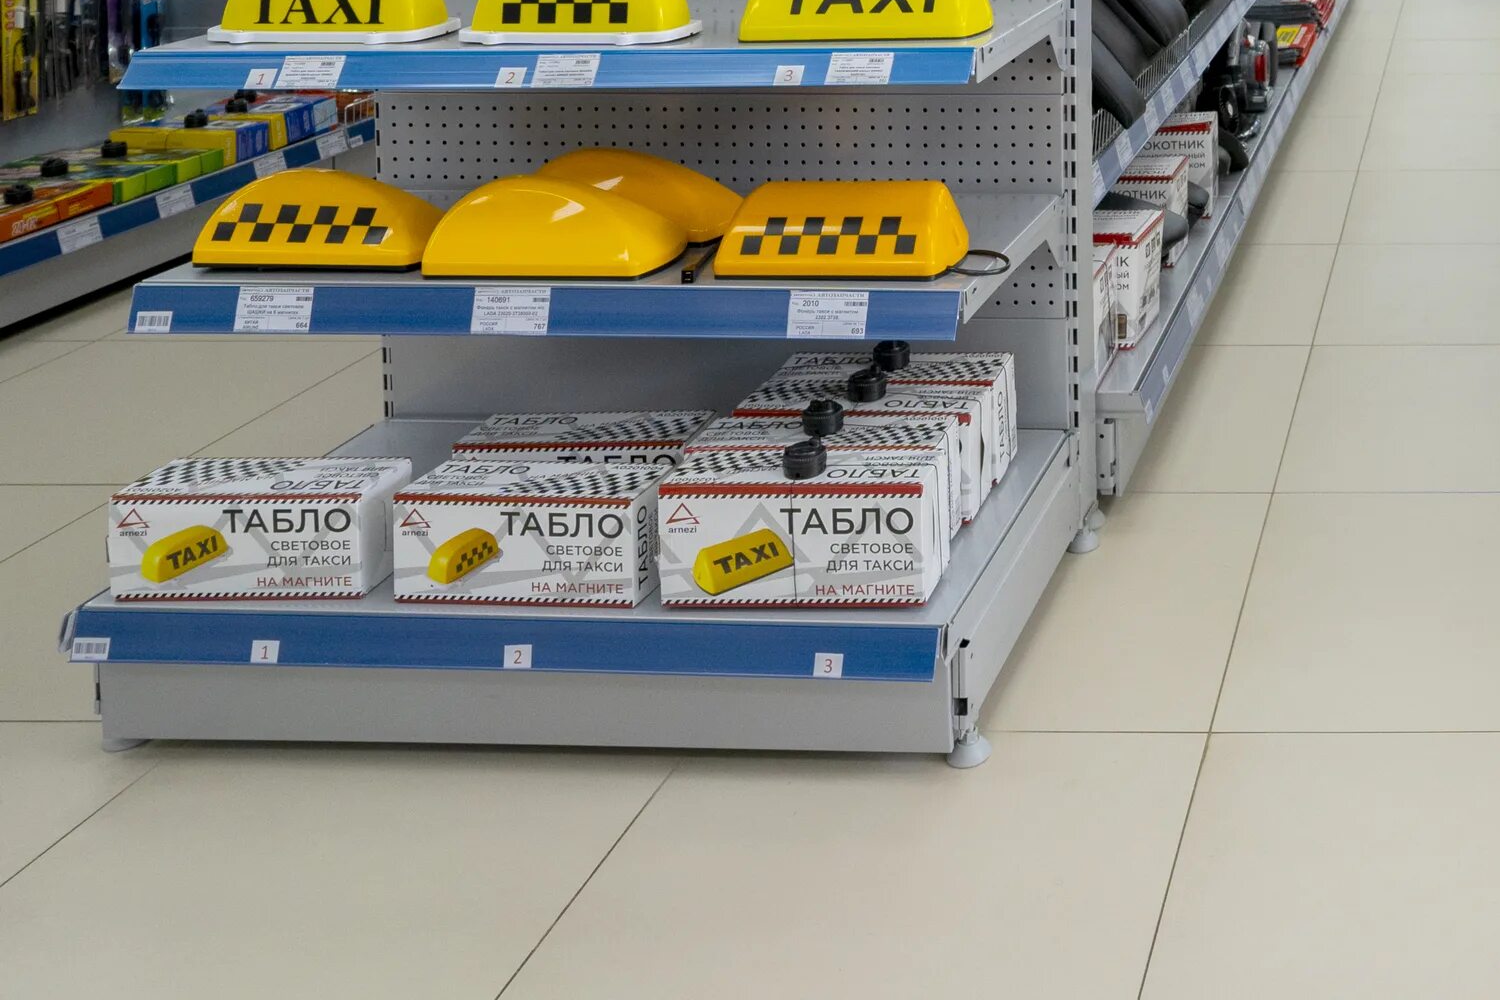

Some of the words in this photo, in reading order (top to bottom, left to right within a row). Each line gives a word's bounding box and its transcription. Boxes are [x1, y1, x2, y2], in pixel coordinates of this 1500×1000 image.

[256, 74, 265, 85] 1
[505, 72, 516, 84] 2
[784, 70, 793, 82] 3
[1143, 140, 1205, 150] ОКОТНИК
[1114, 189, 1167, 200] КОТНИК
[884, 400, 969, 408] ТАБЛО
[491, 416, 578, 425] ТАБЛО
[715, 421, 804, 430] ТАБЛО
[441, 464, 532, 475] ТАБЛО
[826, 469, 920, 478] ТАБЛО
[270, 480, 366, 490] ТАБЛО
[222, 509, 351, 533] ТАБЛО
[500, 512, 624, 539] ТАБЛО
[780, 507, 915, 536] ТАБЛО
[119, 529, 148, 537] arnezi
[402, 529, 429, 537] arnezi
[668, 525, 699, 534] arnezi
[271, 540, 351, 551] СВЕТОВОЕ
[546, 545, 624, 557] СВЕТОВОЕ
[637, 505, 649, 591] ТАБЛО
[830, 542, 914, 554] СВЕТОВОЕ
[166, 535, 220, 571] TAXI
[712, 541, 779, 575] TAXI
[267, 556, 298, 568] ДЛЯ
[302, 555, 351, 566] ТАКСИ
[542, 561, 572, 573] ДЛЯ
[576, 561, 624, 573] ТАКСИ
[826, 560, 859, 573] ДЛЯ
[864, 559, 914, 571] ТАКСИ
[257, 577, 279, 587] НА
[282, 576, 352, 587] МАГНИТЕ
[531, 582, 553, 593] НА
[556, 583, 624, 594] МАГНИТЕ
[815, 584, 838, 596] НА
[842, 584, 915, 596] МАГНИТЕ
[260, 645, 269, 659] 1
[514, 650, 522, 664] 2
[823, 659, 832, 673] 3
